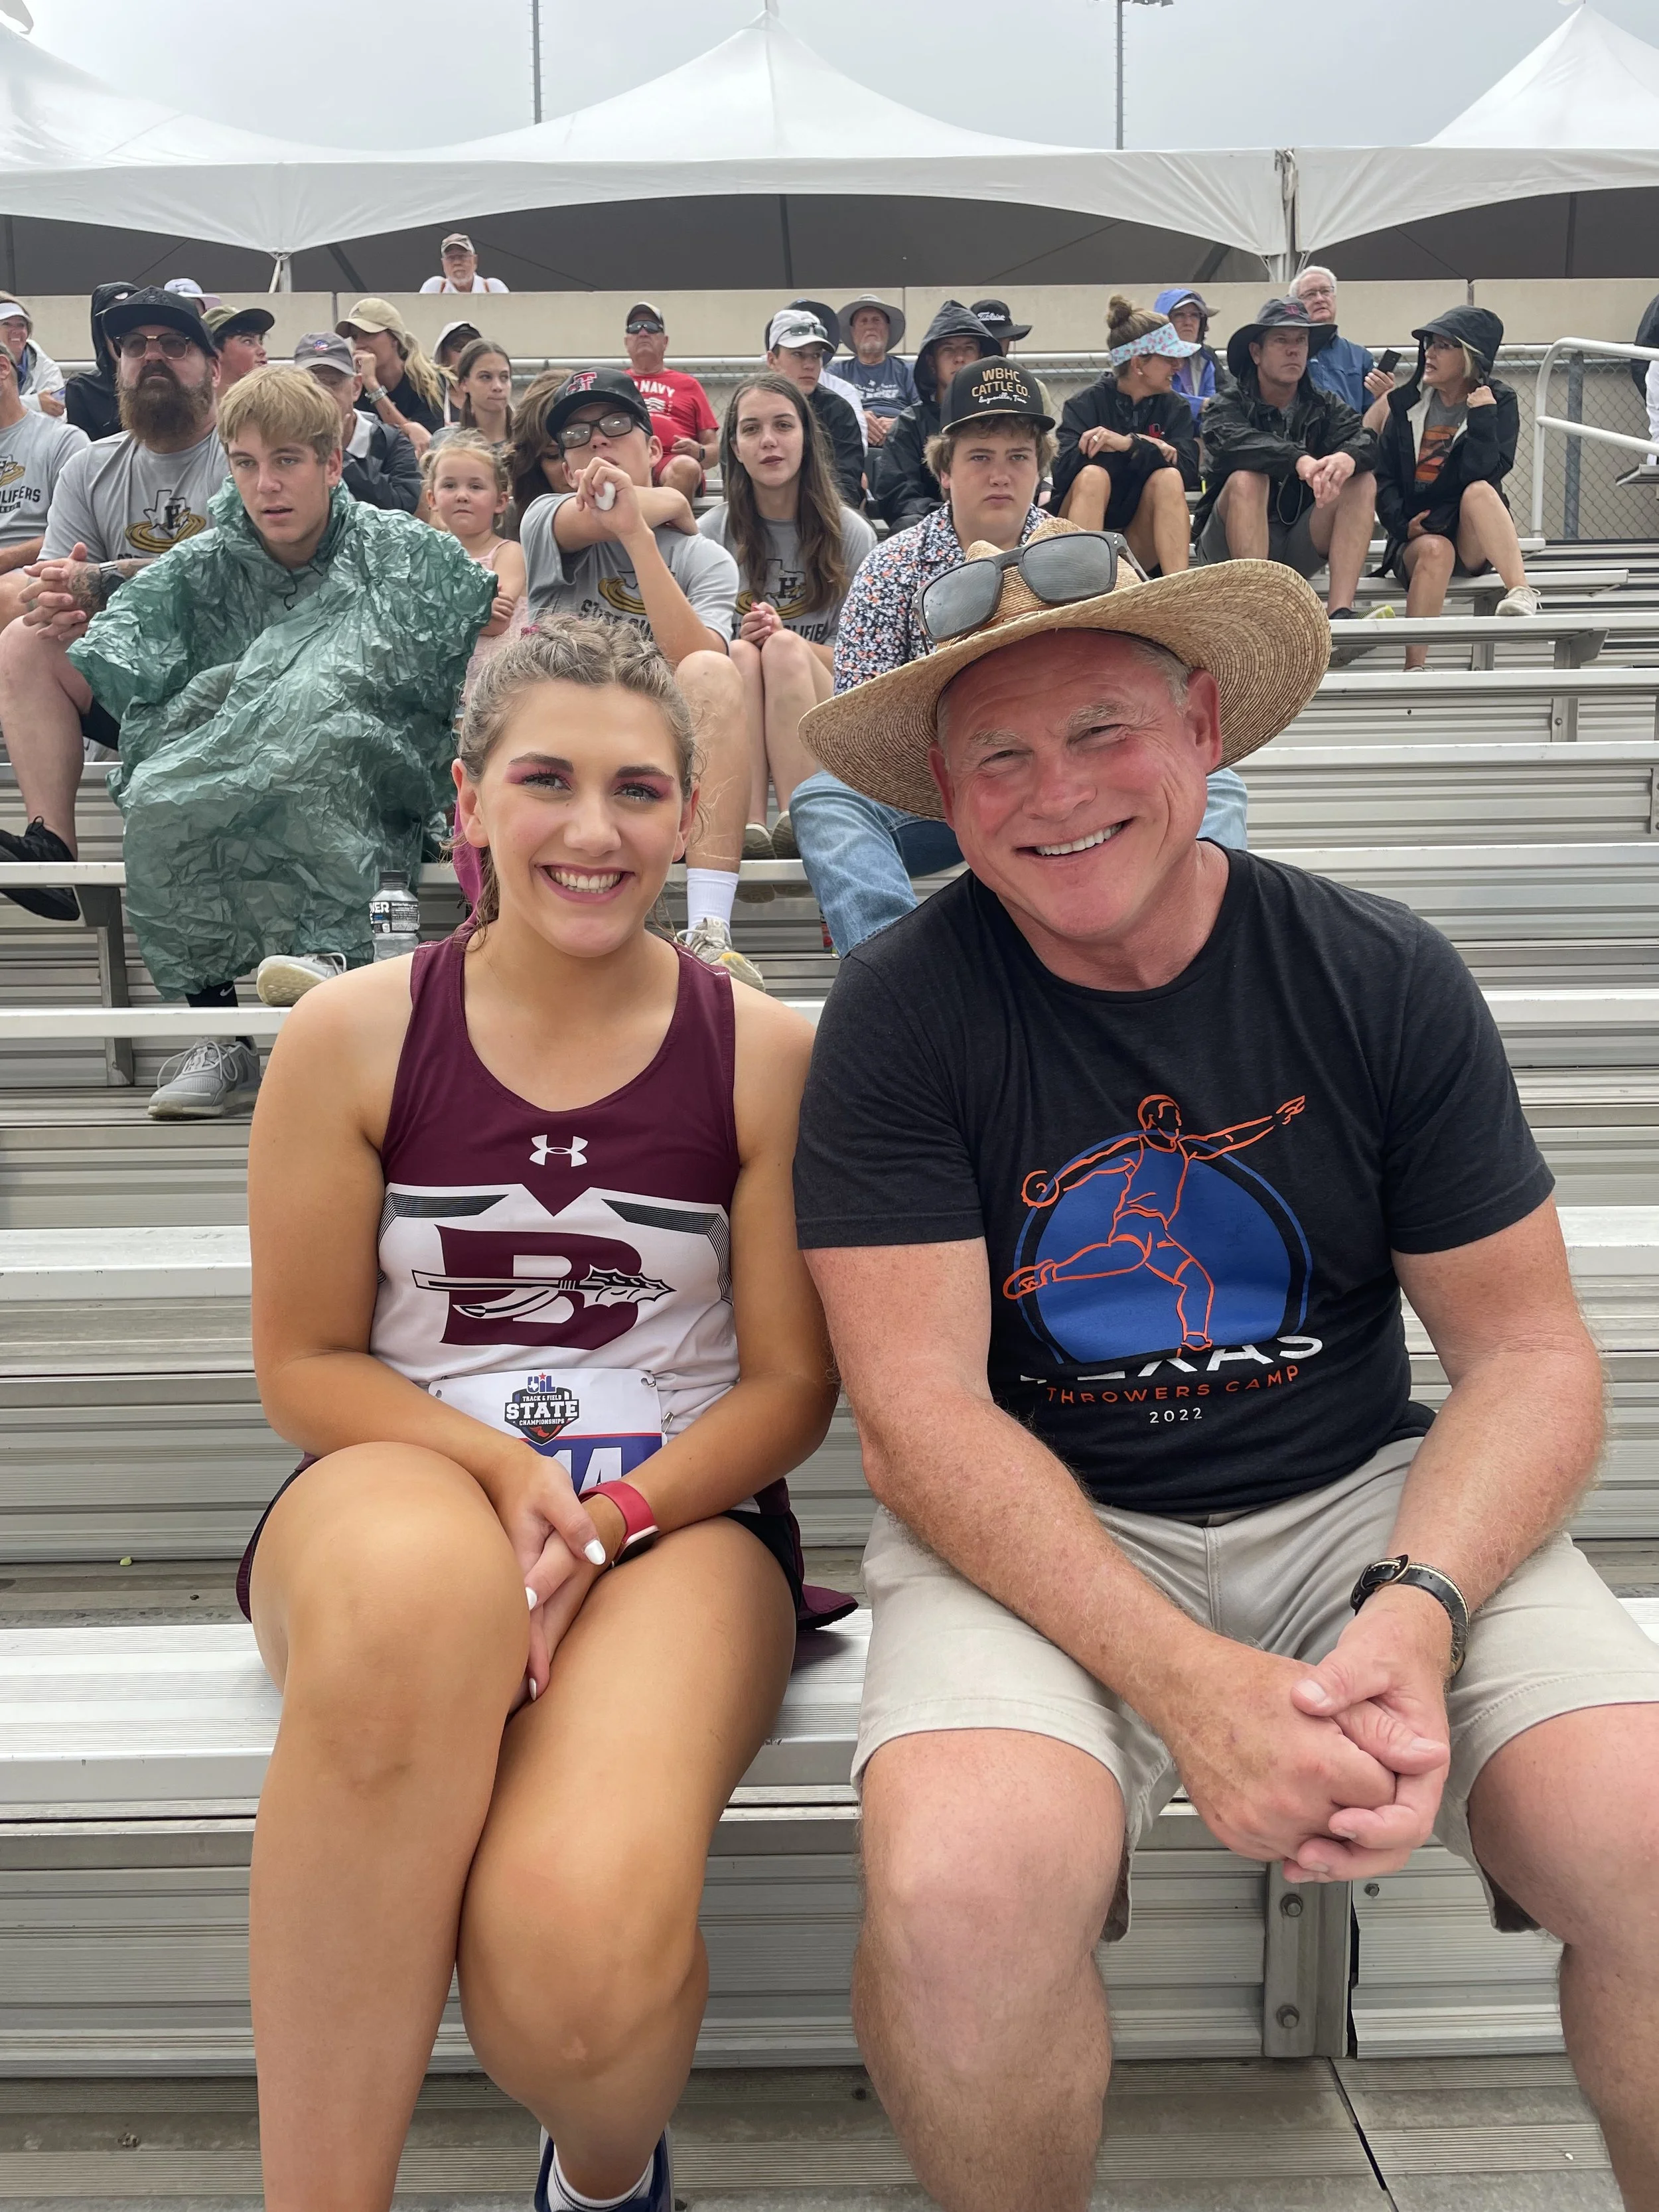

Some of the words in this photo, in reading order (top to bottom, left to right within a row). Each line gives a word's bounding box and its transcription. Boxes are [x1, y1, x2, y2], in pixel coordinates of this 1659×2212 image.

[982, 368, 1021, 382] WBHC
[640, 380, 676, 398] NAVY
[972, 381, 1014, 397] CATTLE
[434, 1224, 642, 1351] B
[1046, 1384, 1210, 1404] THROWERS
[1225, 1364, 1299, 1392] CAMP
[506, 1400, 578, 1420] STATE
[1149, 1407, 1202, 1424] 2022
